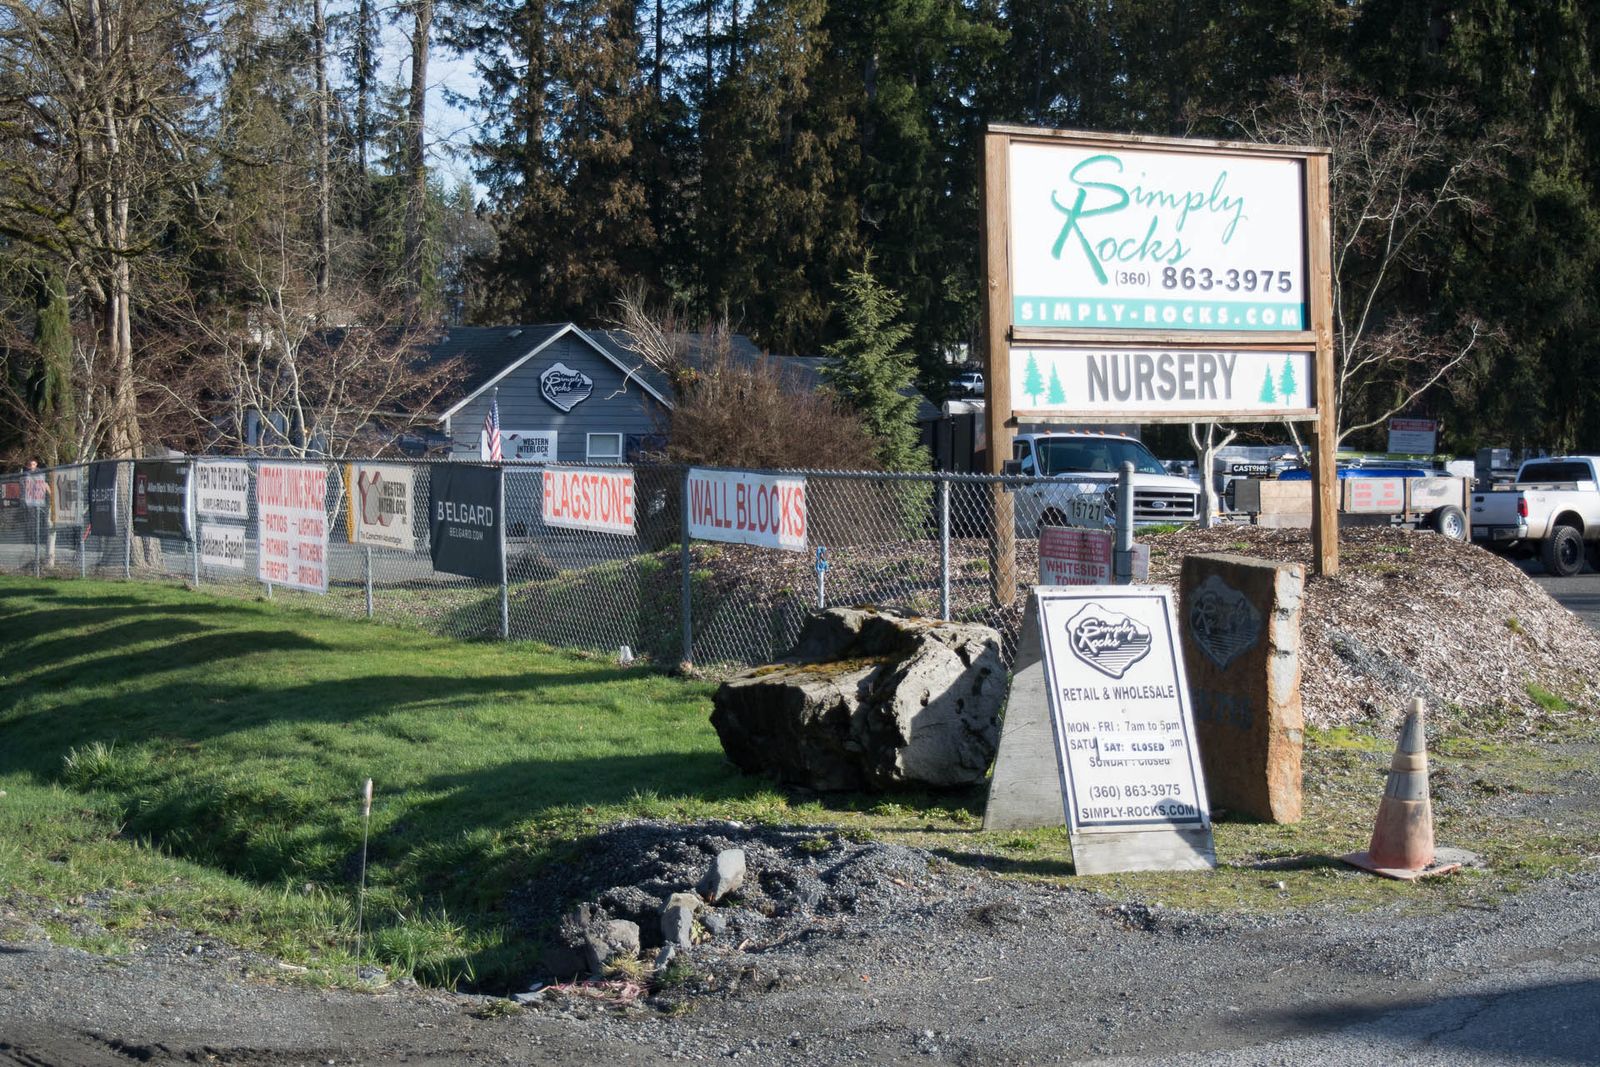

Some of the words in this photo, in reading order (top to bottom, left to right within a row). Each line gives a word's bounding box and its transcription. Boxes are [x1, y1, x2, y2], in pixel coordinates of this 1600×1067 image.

[1054, 154, 1249, 245] Simply
[1050, 187, 1191, 286] Rocks
[1114, 269, 1152, 288] (360)
[1161, 265, 1293, 294] 863-3975
[1020, 301, 1299, 328] SIMPLY-ROCKS.COM
[544, 376, 573, 396] Rocks
[548, 371, 585, 388] Simply
[1086, 353, 1238, 403] NURSERY
[516, 445, 549, 454] INTERLOCK
[523, 437, 549, 446] WESTERN
[383, 480, 407, 499] WESTERN
[544, 471, 633, 525] FLAGSTONE
[378, 497, 407, 516] INTERLOCK
[437, 500, 494, 527] BELGARD
[689, 478, 732, 529] WALL
[736, 482, 805, 538] BLOCKS
[1071, 500, 1101, 521] 15727
[266, 513, 288, 533] PATIOS
[449, 527, 484, 541] BELGARD.COM
[1045, 559, 1106, 578] WHITESIDE
[1079, 616, 1138, 641] Simply
[1076, 625, 1121, 655] Rocks
[1063, 687, 1100, 702] RETAIL
[1102, 687, 1110, 700] &
[1112, 684, 1176, 701] WHOLESALE
[1067, 721, 1091, 733] MON
[1098, 721, 1114, 732] FRI
[1124, 720, 1146, 732] 7am
[1147, 721, 1158, 731] to
[1159, 720, 1181, 734] 5pm
[1104, 742, 1125, 752] SAT:
[1130, 741, 1166, 752] CLOSED
[1089, 784, 1121, 801] (360)
[1124, 783, 1182, 798] 863-3975
[1081, 803, 1195, 820] SIMPLY-ROCKS.COM
